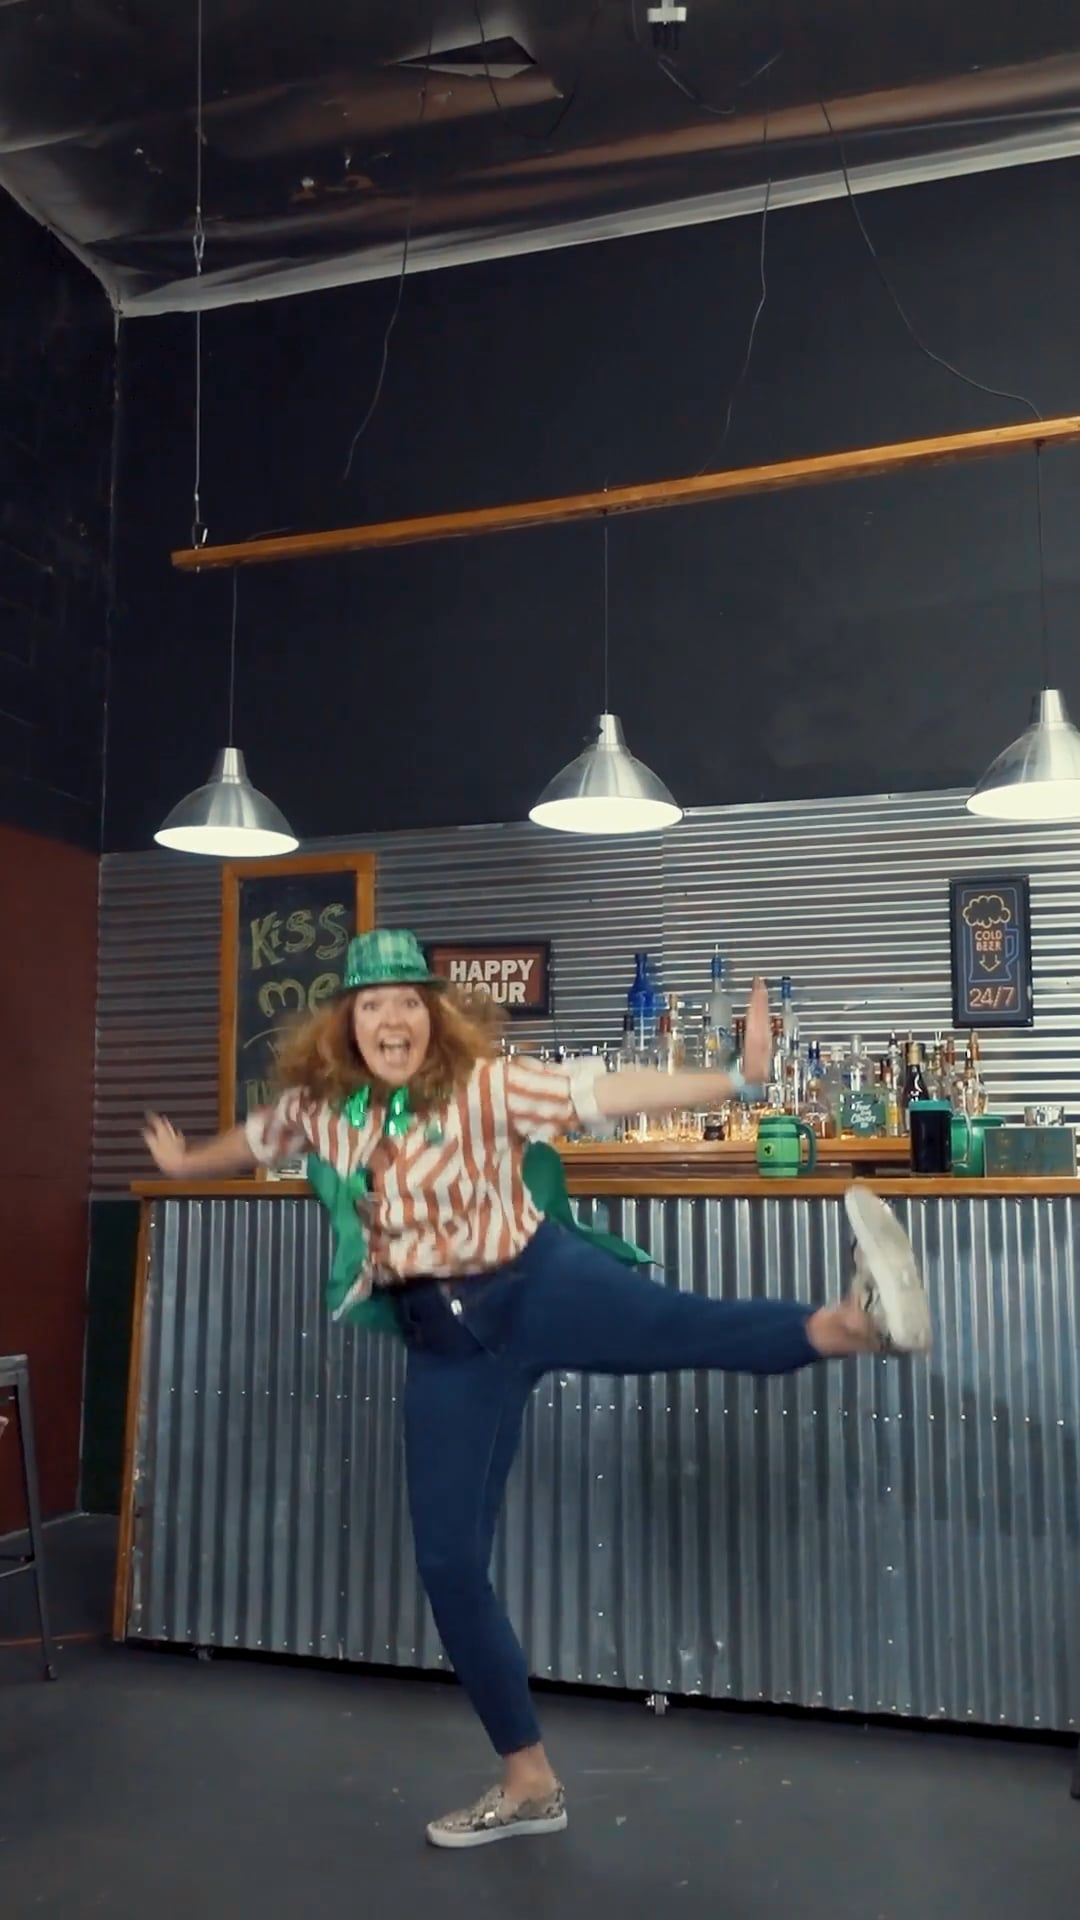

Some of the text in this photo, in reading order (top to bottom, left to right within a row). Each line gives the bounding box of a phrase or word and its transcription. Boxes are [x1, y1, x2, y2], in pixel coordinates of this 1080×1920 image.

[975, 930, 1002, 941] COLD
[976, 941, 1002, 951] BEER
[450, 960, 534, 981] HAPPY
[969, 986, 1015, 1008] 24/7
